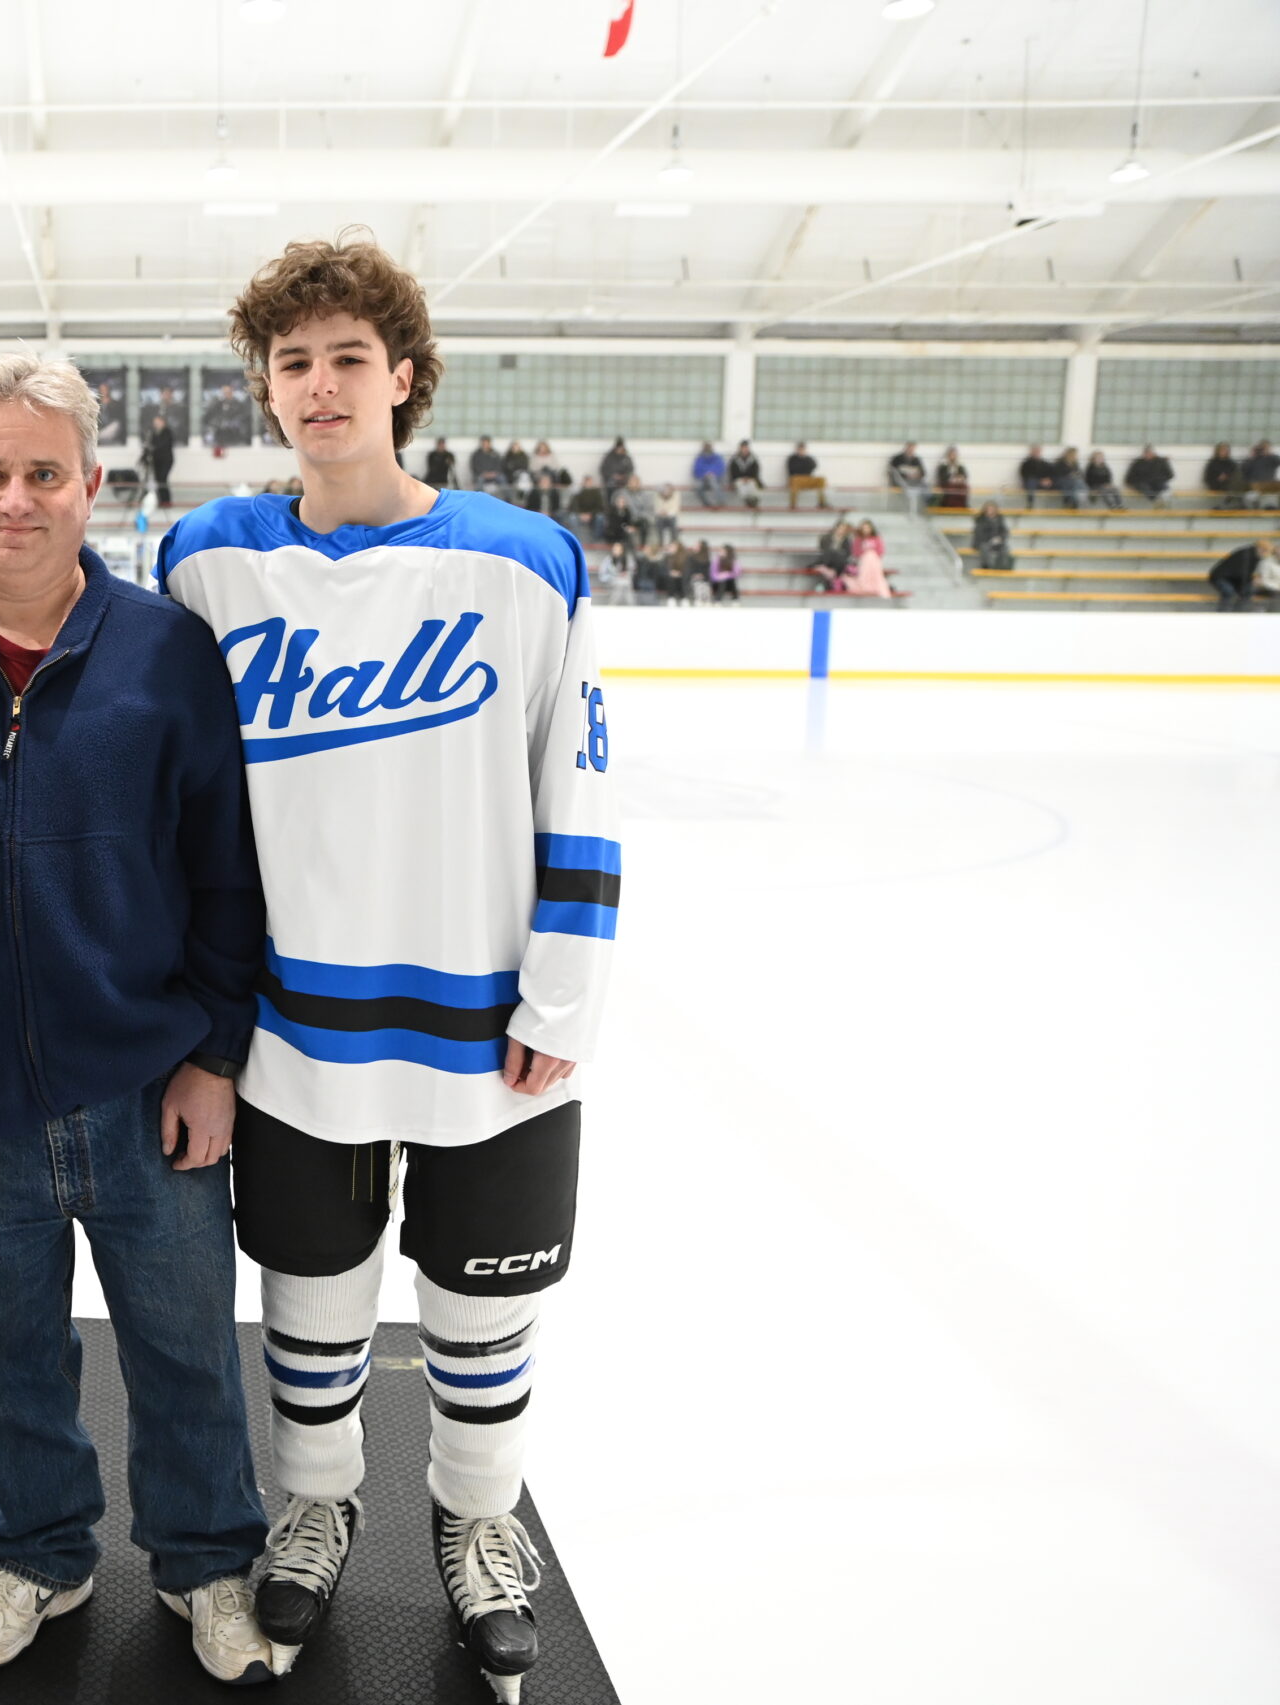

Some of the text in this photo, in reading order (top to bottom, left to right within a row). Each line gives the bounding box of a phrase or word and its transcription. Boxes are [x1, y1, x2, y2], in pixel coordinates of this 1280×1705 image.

[219, 611, 499, 729] Hall
[576, 681, 609, 773] 18
[463, 1243, 562, 1275] CCM
